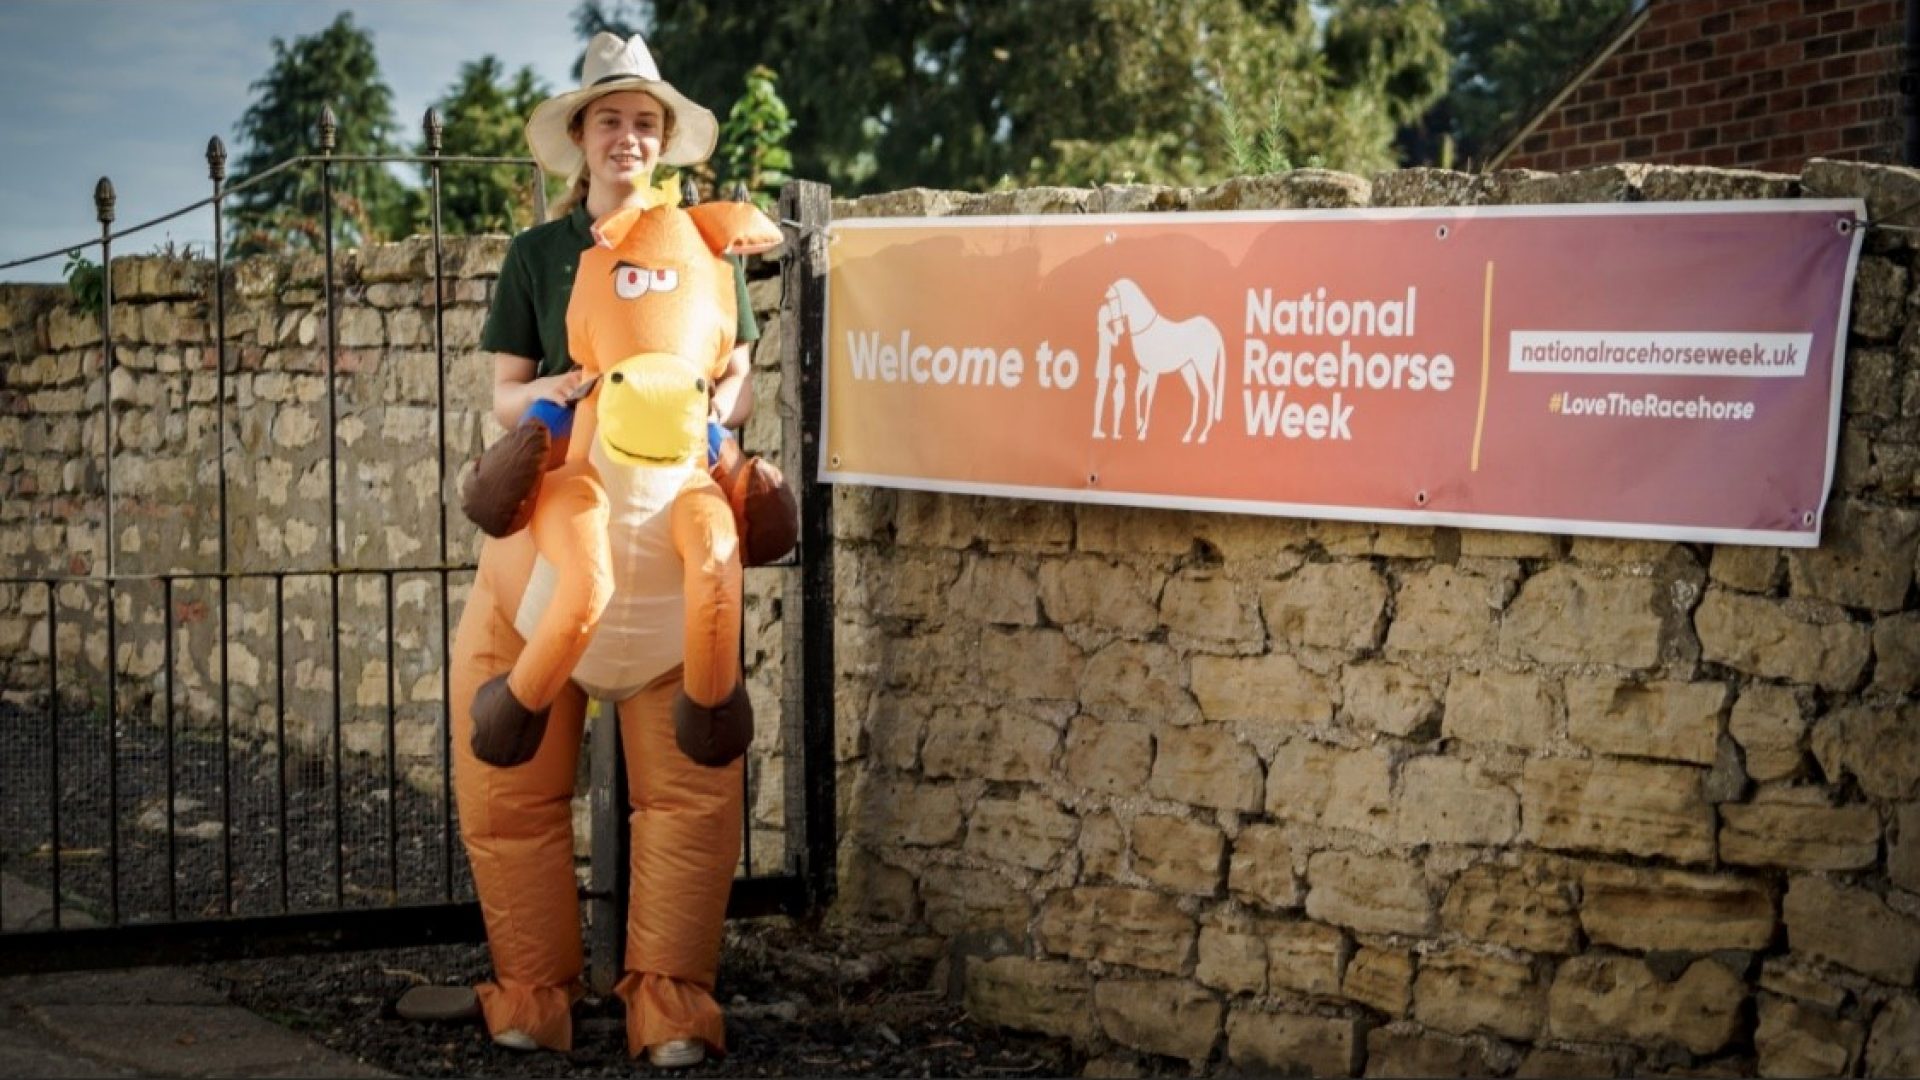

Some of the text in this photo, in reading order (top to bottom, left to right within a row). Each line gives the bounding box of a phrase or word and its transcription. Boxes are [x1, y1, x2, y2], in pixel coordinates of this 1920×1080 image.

[1245, 286, 1417, 336] National
[846, 329, 1079, 390] Welcome to
[1243, 339, 1455, 391] Racehorse
[1521, 340, 1798, 367] nationalracehorseweek.uk
[1243, 389, 1354, 440] Week
[1549, 392, 1755, 420] #LoveTheRacehorse
